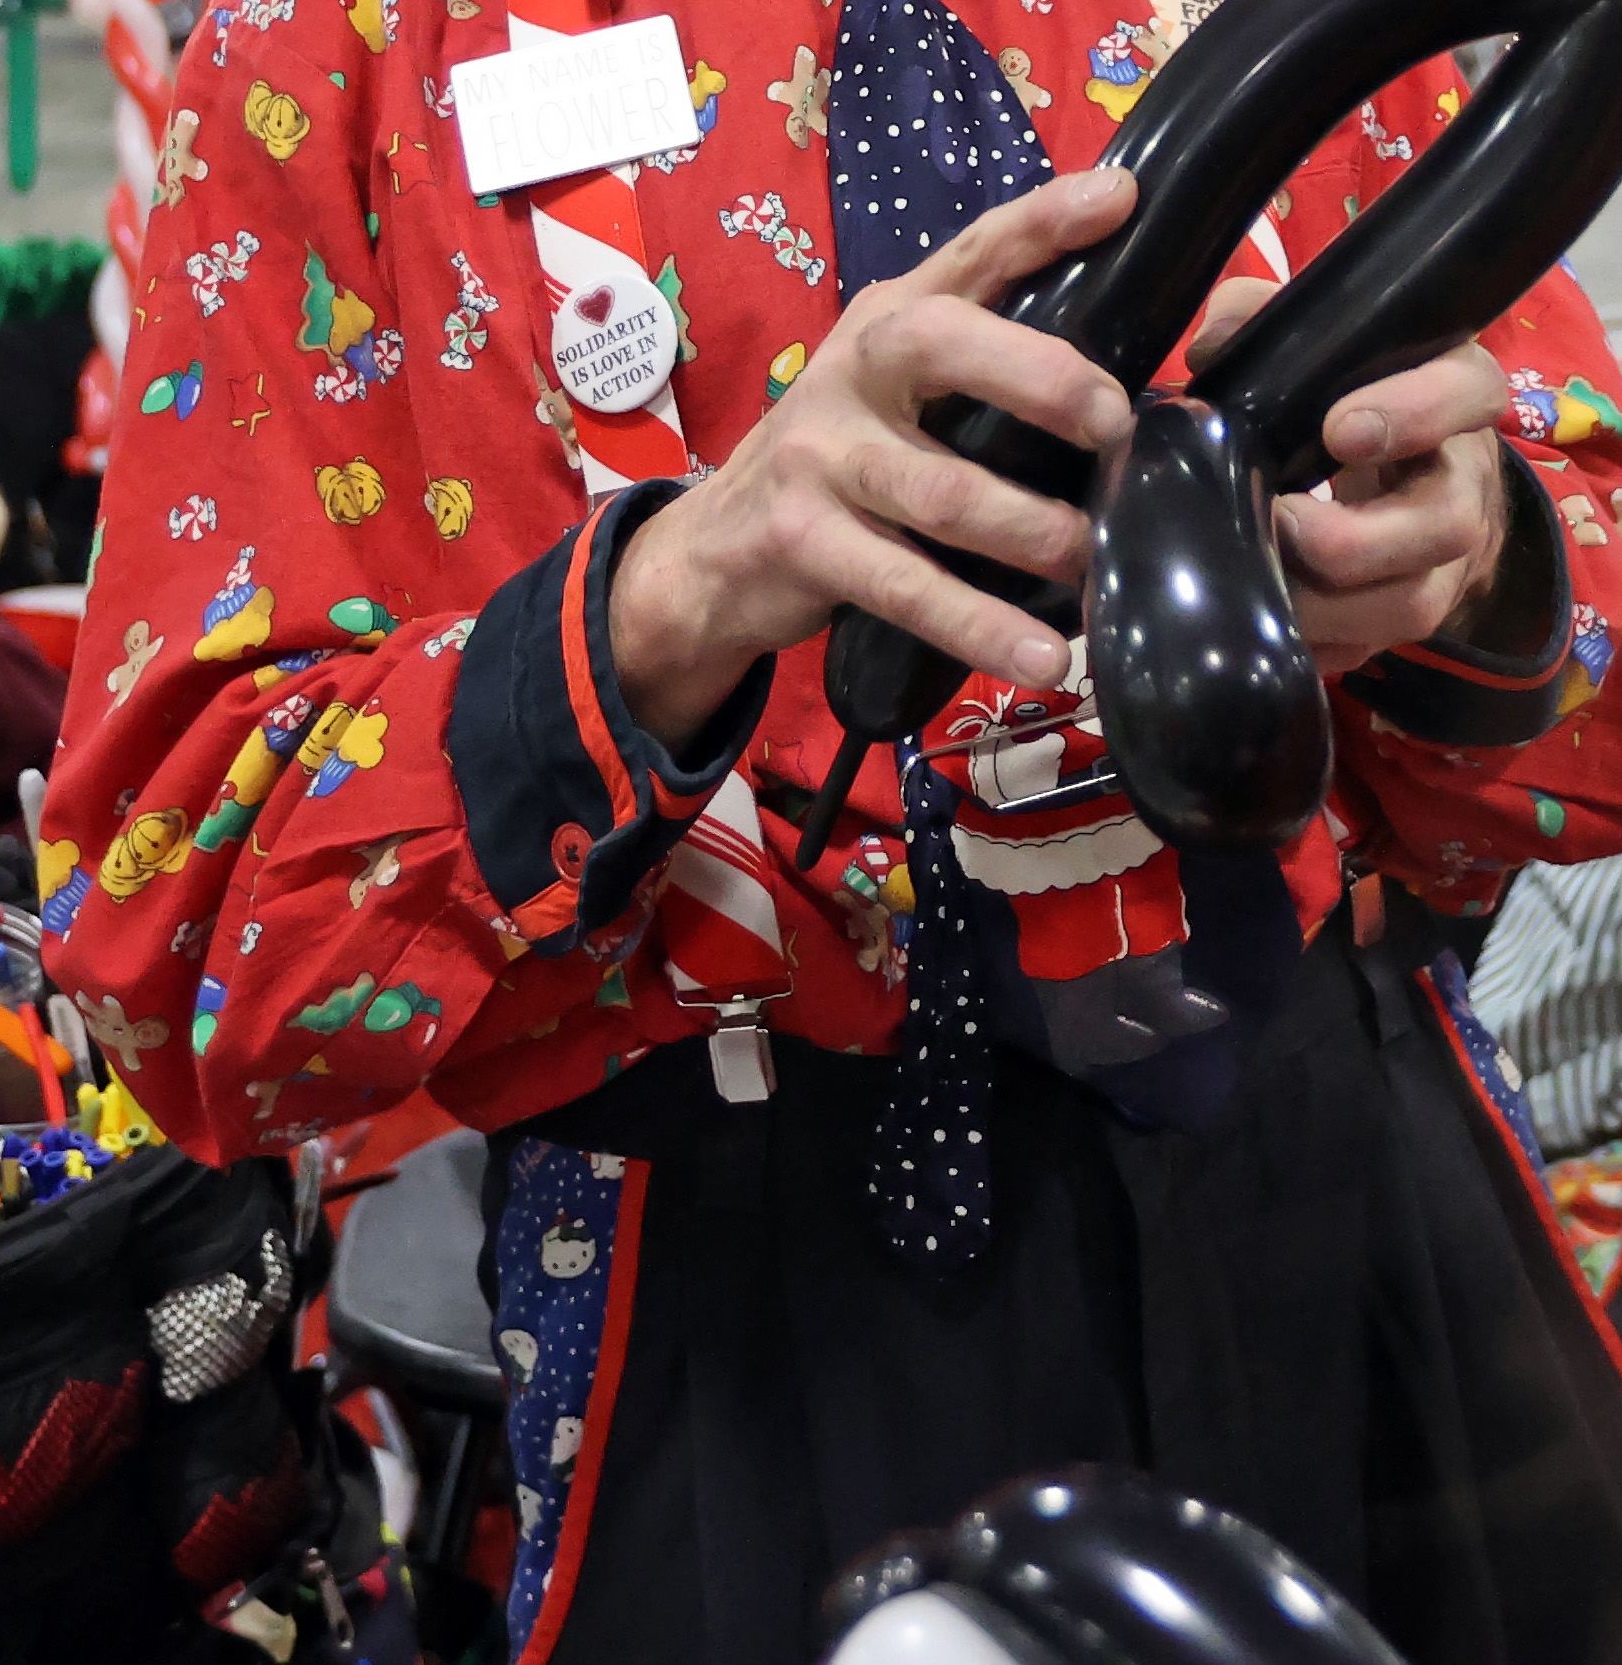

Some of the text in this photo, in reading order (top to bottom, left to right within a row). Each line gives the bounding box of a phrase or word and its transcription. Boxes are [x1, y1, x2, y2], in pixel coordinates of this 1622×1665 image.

[1181, 2, 1211, 21] FO
[463, 33, 665, 108] MY NAME IS
[489, 77, 675, 174] FLOWER
[557, 306, 658, 368] SOLIDARITY
[571, 333, 658, 387] IS LOVE IN
[592, 359, 656, 405] ACTION
